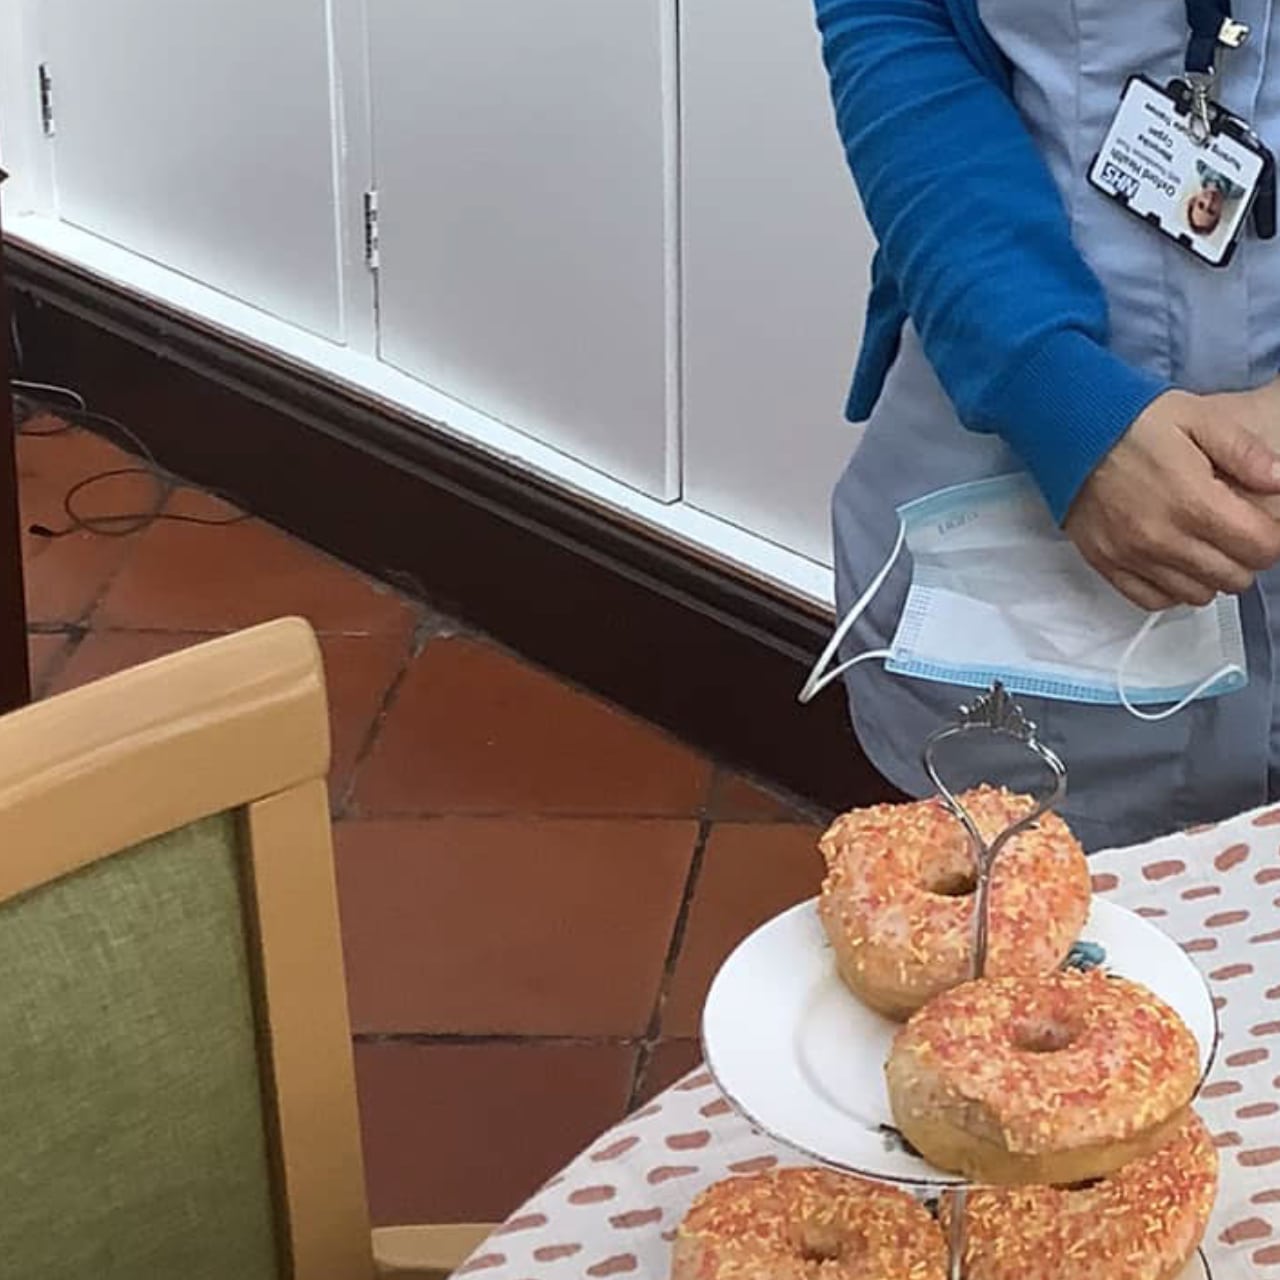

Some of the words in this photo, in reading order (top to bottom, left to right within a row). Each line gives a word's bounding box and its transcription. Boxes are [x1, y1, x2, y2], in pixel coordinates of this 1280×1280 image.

[1109, 146, 1143, 177] Health
[1099, 161, 1141, 199] NHS
[1139, 166, 1177, 199] Oxford
